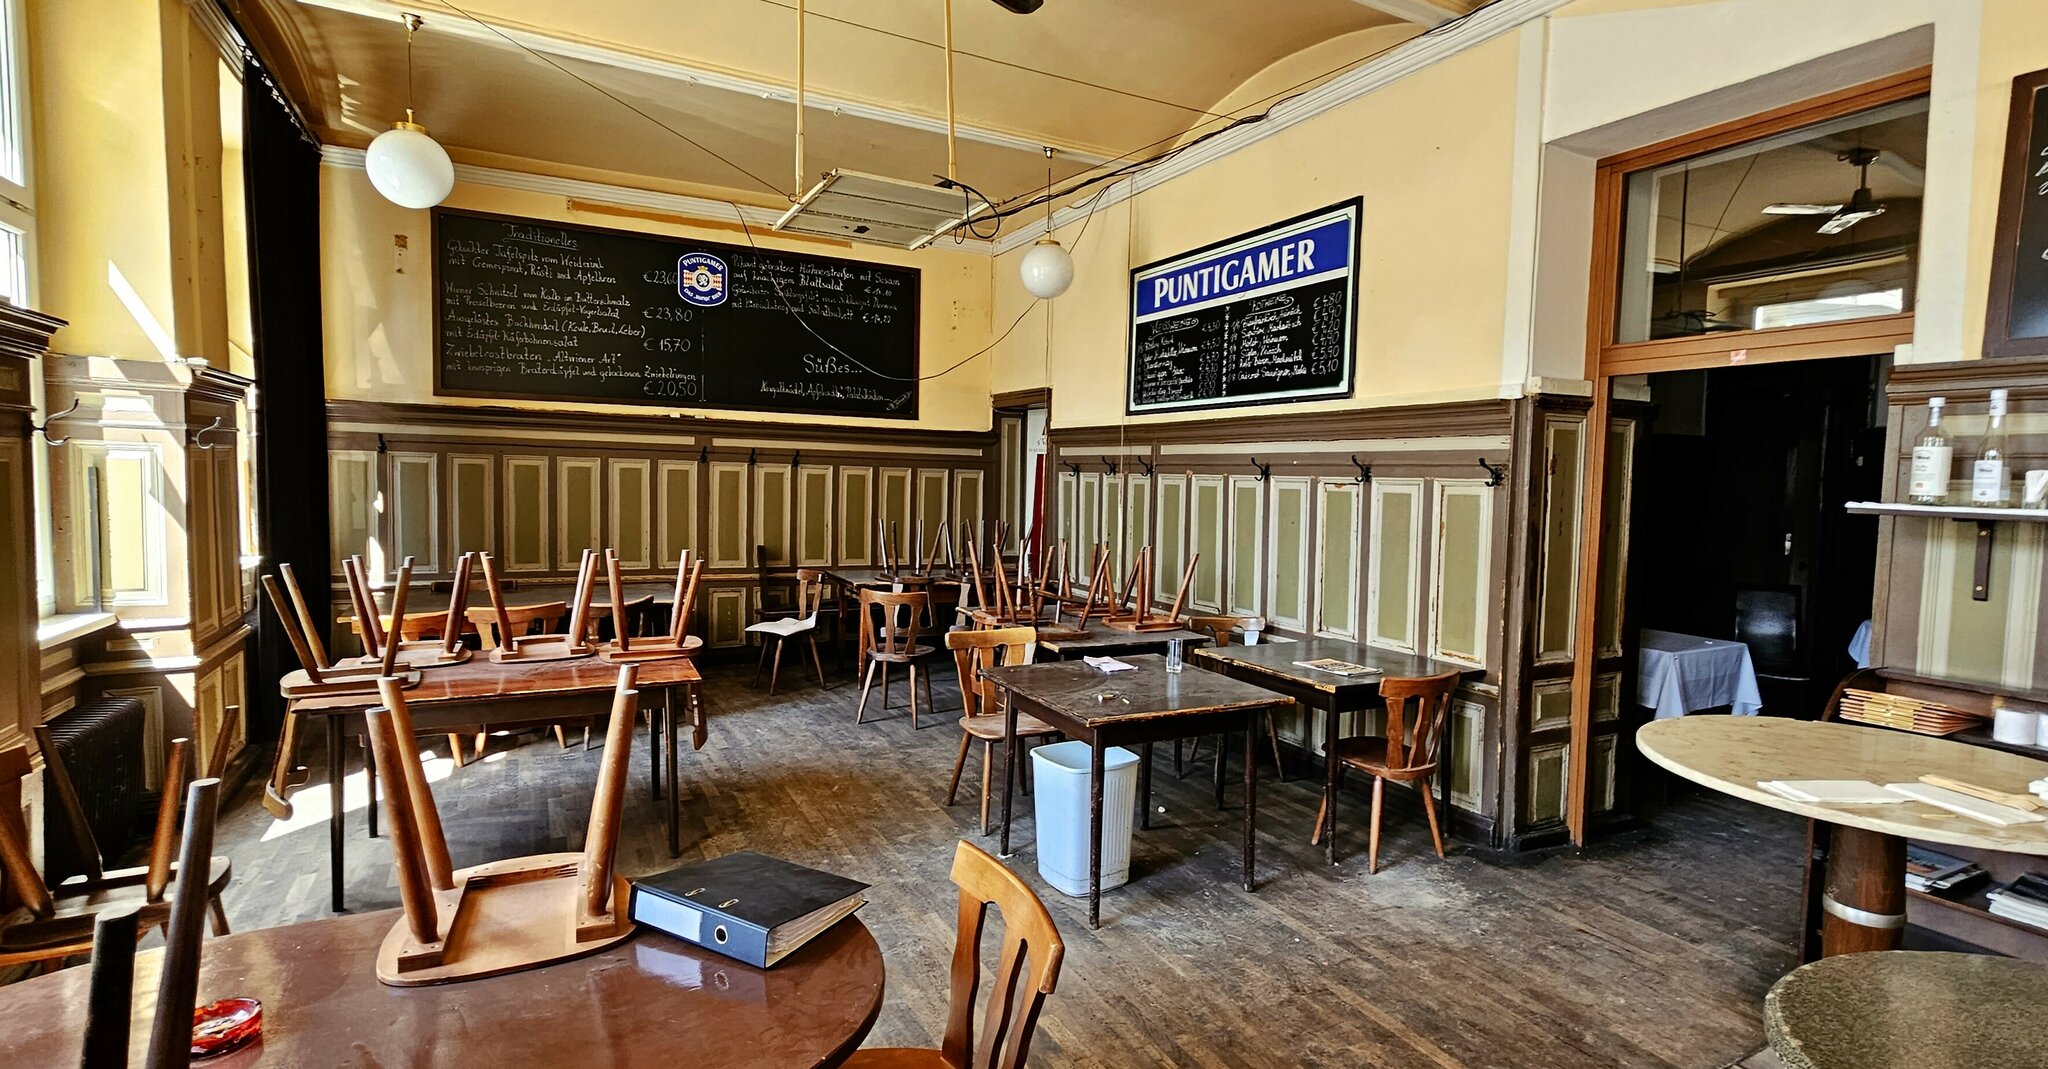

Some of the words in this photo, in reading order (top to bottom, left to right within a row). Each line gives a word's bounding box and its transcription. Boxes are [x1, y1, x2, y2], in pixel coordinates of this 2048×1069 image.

[502, 223, 578, 248] Traditionelles
[682, 257, 724, 272] PUNTIGAMER
[1154, 239, 1315, 309] PUNTIGAMER
